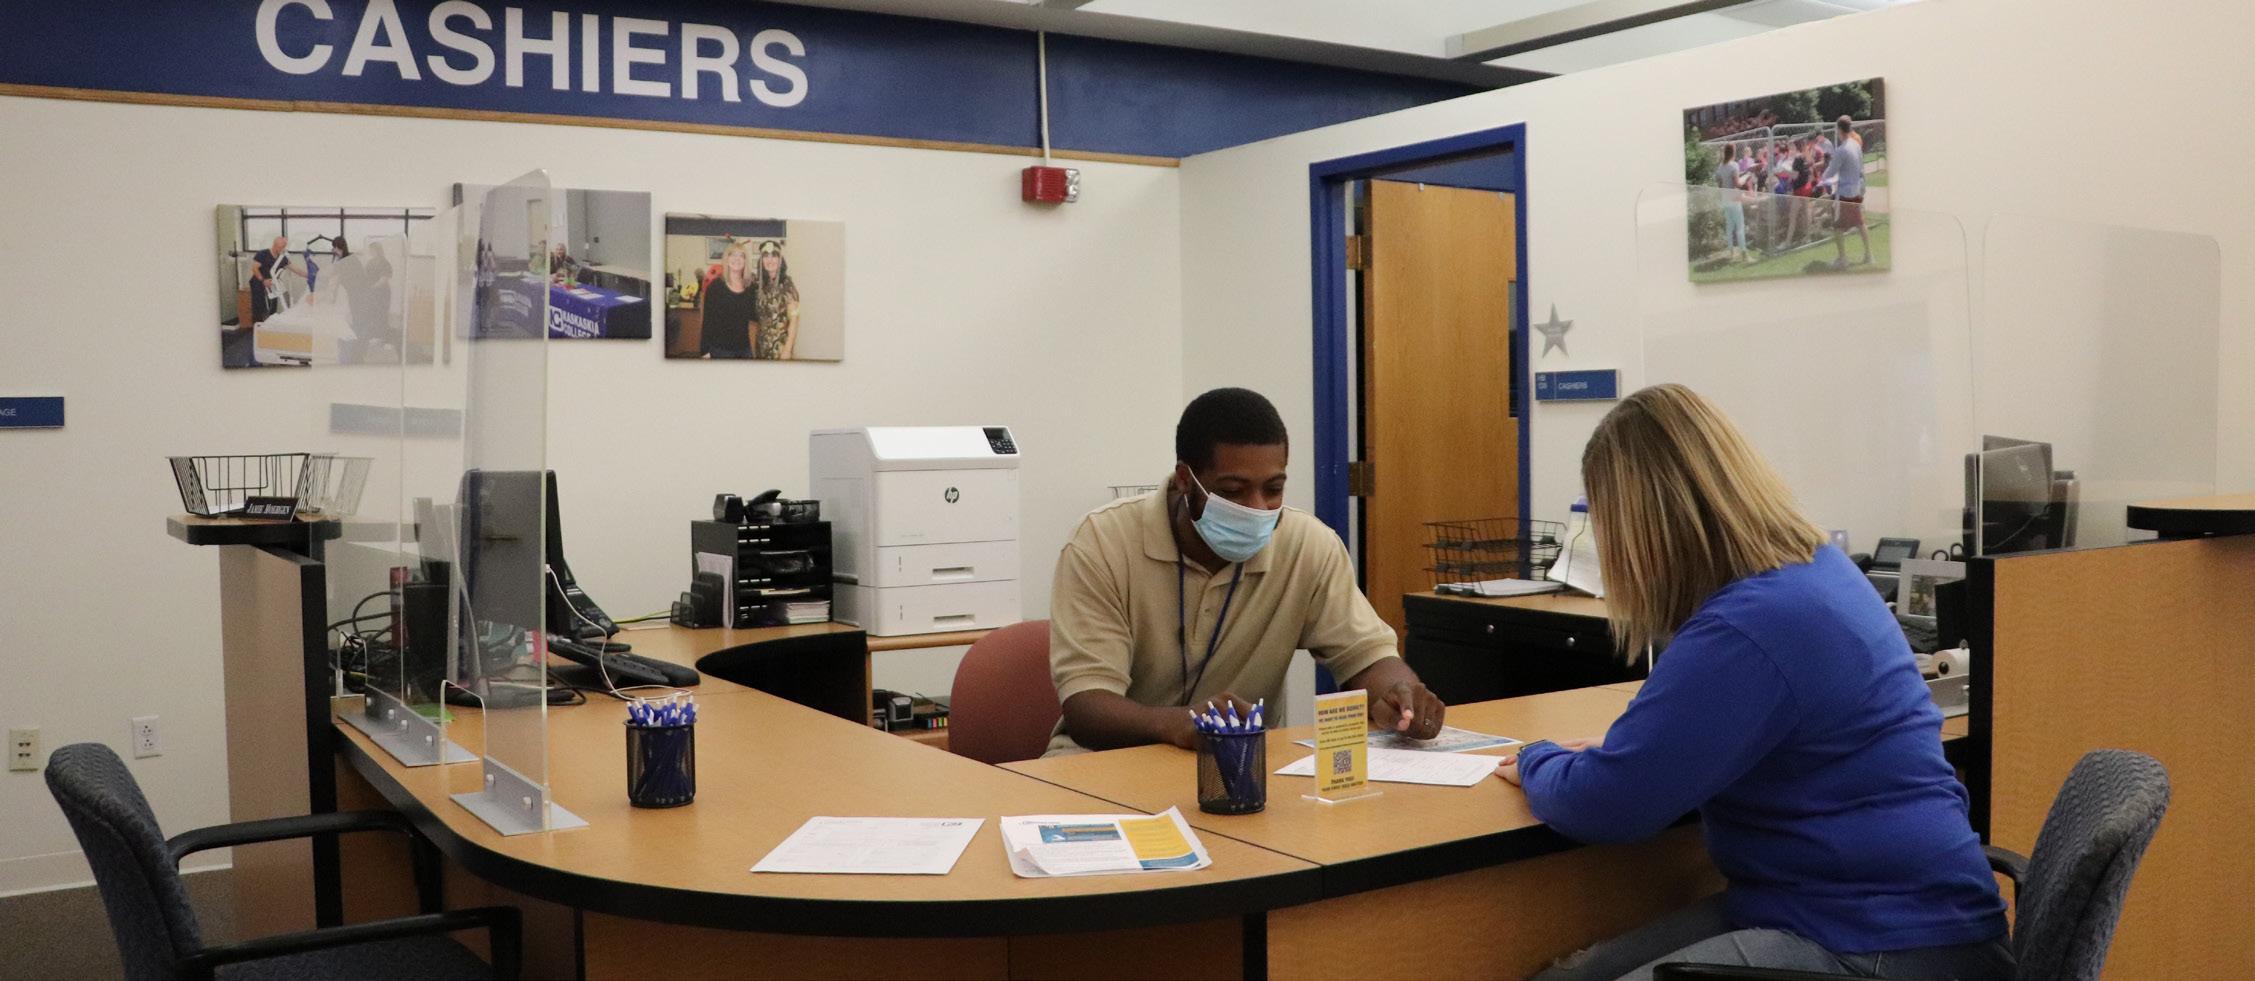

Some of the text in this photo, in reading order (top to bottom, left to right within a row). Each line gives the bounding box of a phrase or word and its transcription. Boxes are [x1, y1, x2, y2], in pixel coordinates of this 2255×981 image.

[255, 0, 809, 108] CASHIERS
[562, 310, 601, 337] KASKASKIA
[944, 486, 960, 504] hp
